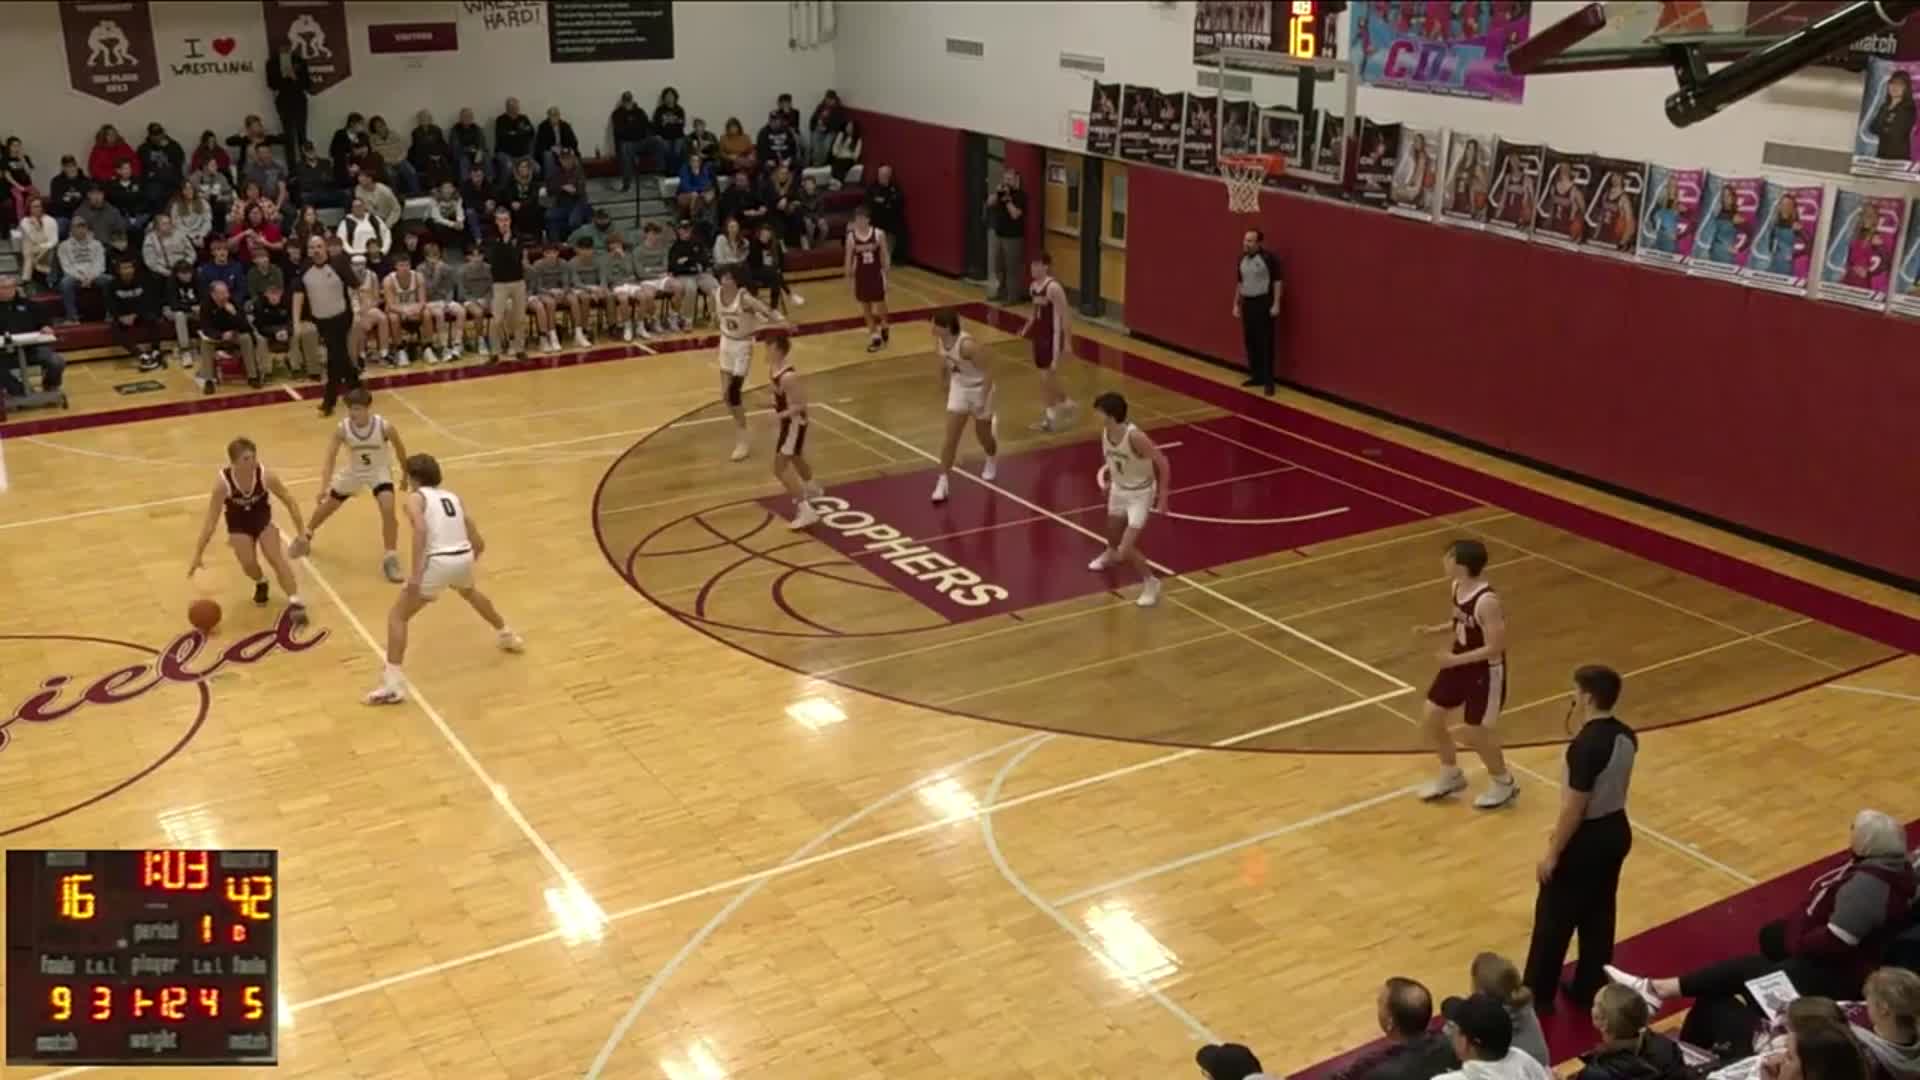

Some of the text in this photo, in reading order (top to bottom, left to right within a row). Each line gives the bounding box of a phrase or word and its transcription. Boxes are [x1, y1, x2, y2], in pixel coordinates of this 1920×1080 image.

[483, 8, 541, 31] HARD!
[1289, 16, 1315, 59] 16
[184, 38, 204, 59] I
[440, 497, 457, 518] 0
[809, 496, 1009, 607] GOPHERS
[0, 601, 330, 752] ield
[144, 850, 209, 889] 1:03
[60, 873, 95, 920] 16
[226, 875, 273, 920] 42
[200, 914, 213, 944] 1
[51, 985, 73, 1021] 9
[92, 985, 113, 1021] 3
[200, 987, 220, 1019] 4
[243, 985, 264, 1021] 5
